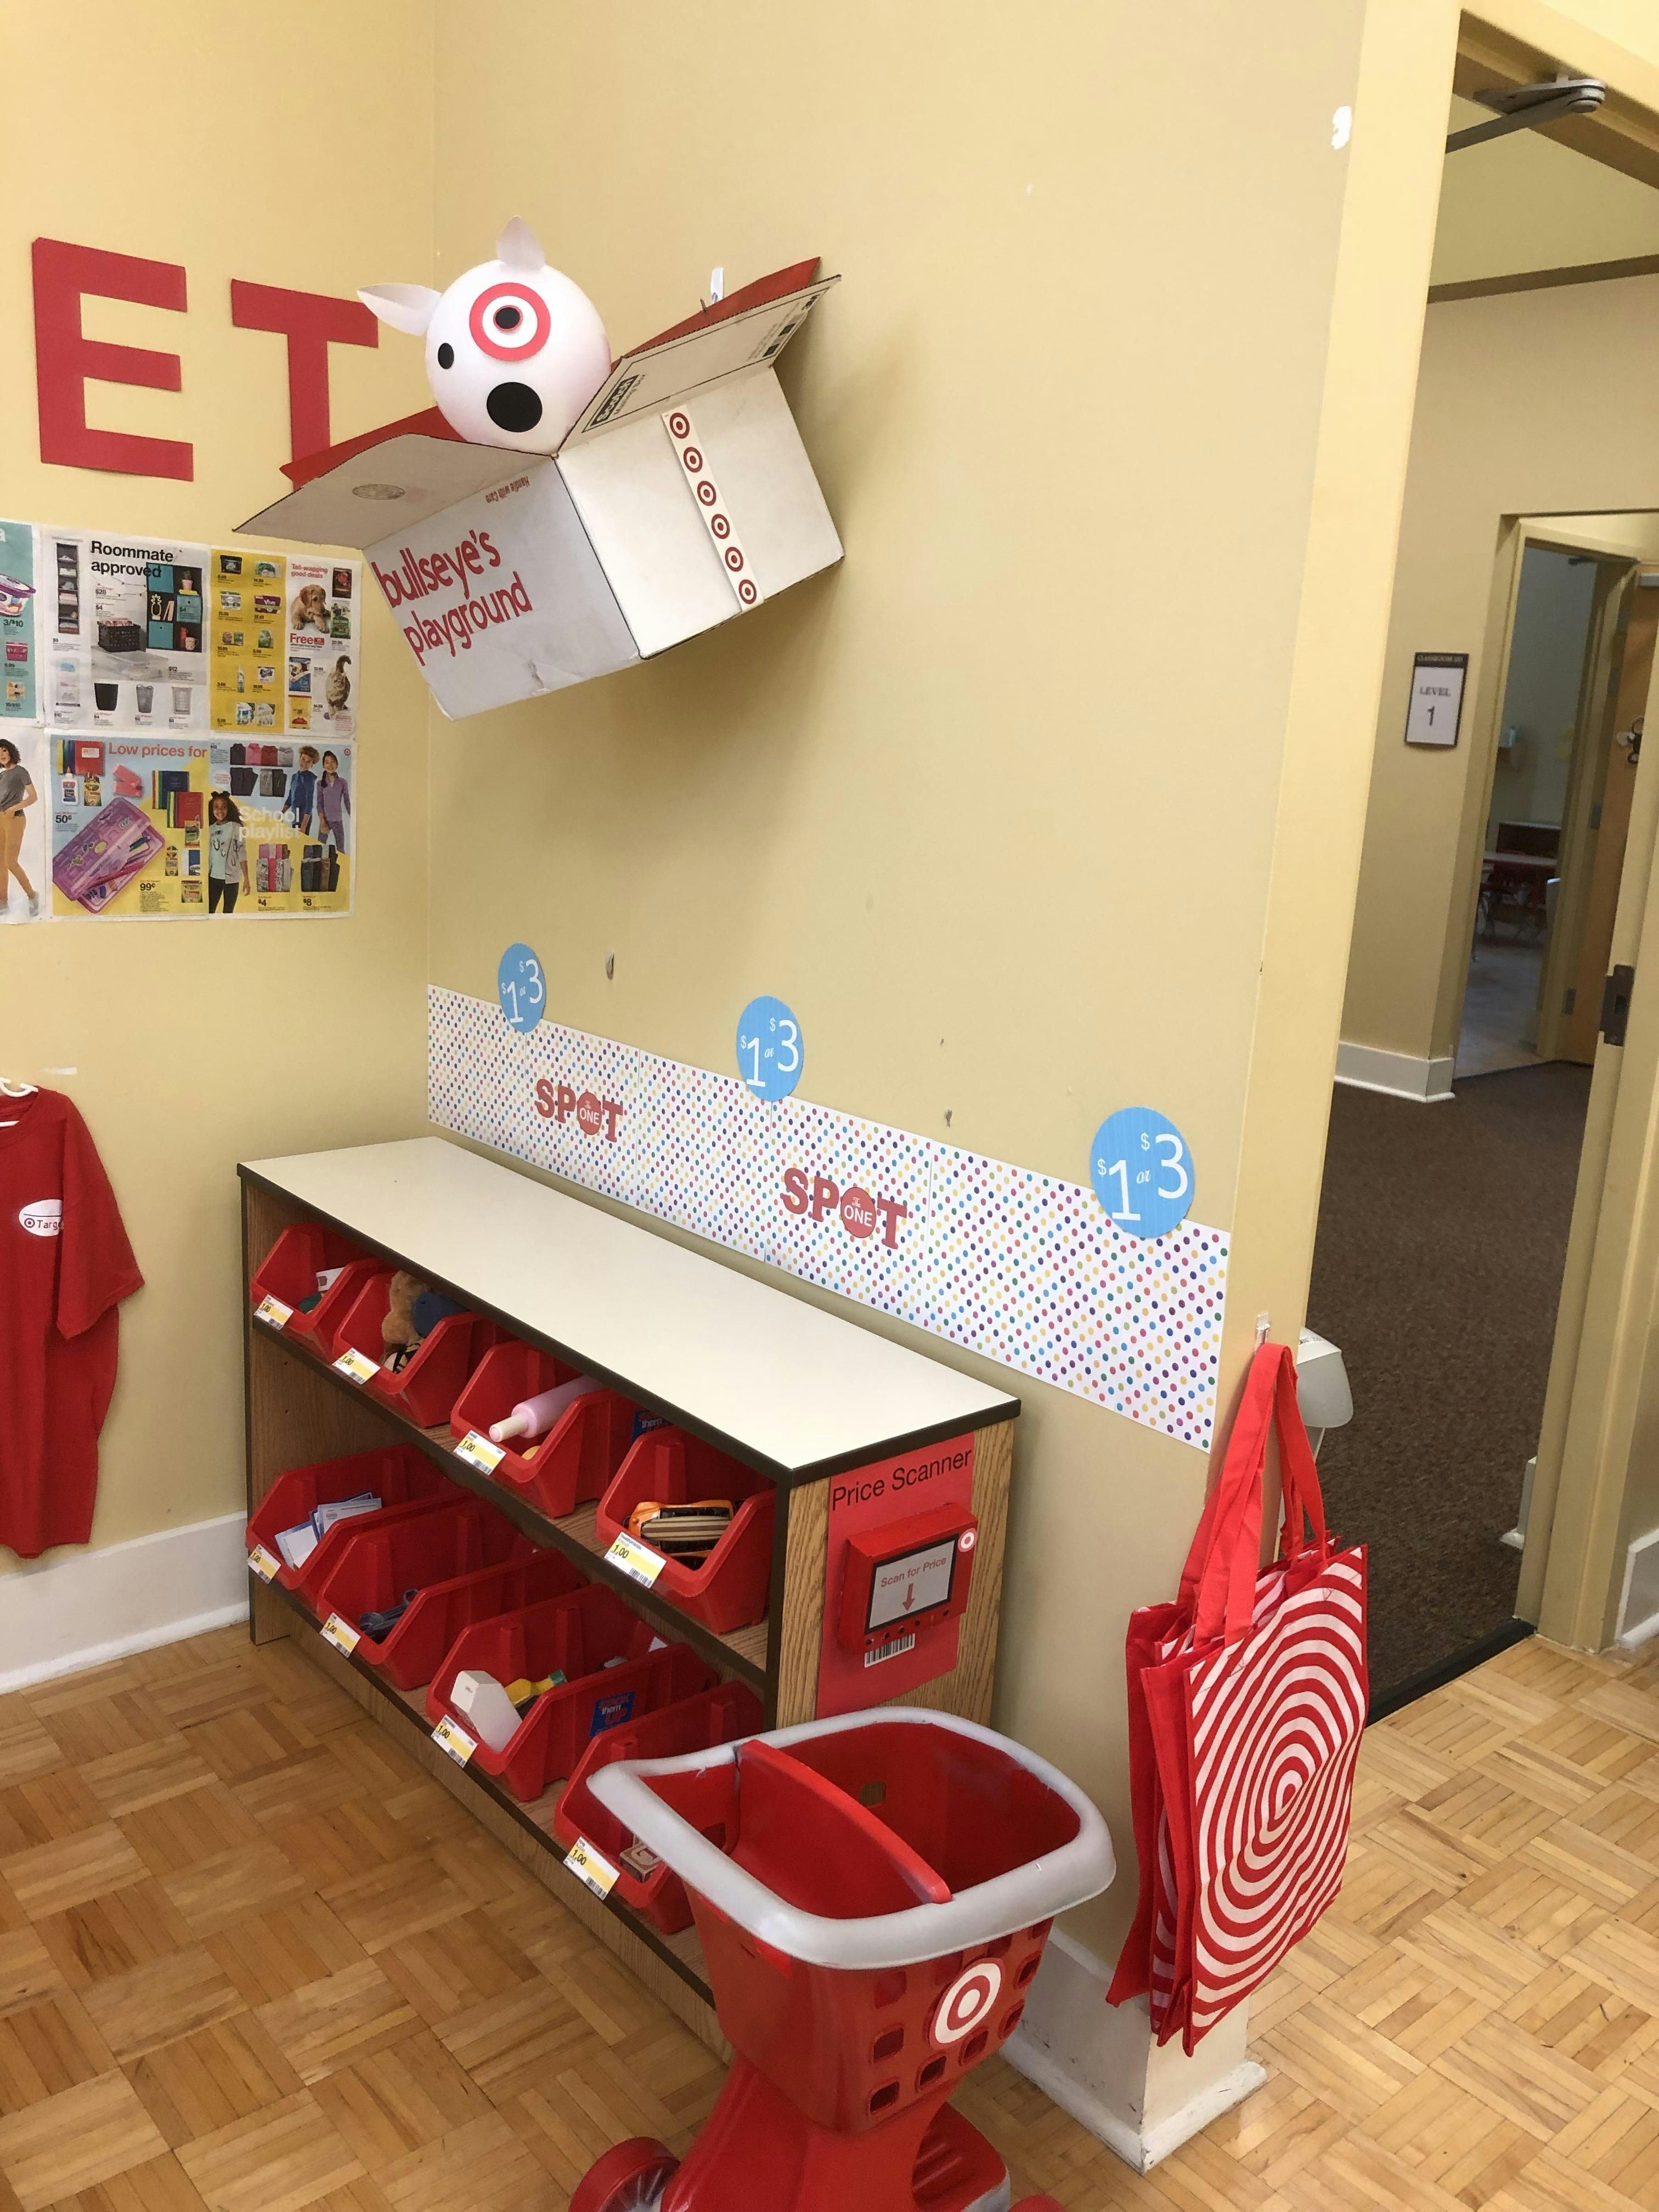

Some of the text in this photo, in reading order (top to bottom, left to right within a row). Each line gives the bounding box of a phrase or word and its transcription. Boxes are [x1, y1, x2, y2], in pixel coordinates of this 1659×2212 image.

[486, 476, 530, 503] Handle with Care
[91, 540, 173, 562] Roommate
[91, 561, 162, 578] approved
[292, 563, 328, 574] Tail-wagging
[371, 529, 501, 608] bullseye's
[403, 571, 533, 667] playground
[290, 633, 313, 644] Free
[1420, 686, 1451, 697] LEVEL
[1427, 706, 1435, 726] 1
[109, 742, 138, 754] Low
[142, 744, 185, 758] prices
[188, 746, 207, 758] for
[55, 815, 72, 823] 50¢
[239, 807, 300, 822] School
[239, 823, 301, 842] playlist
[140, 883, 156, 891] 99¢
[501, 980, 524, 1023] $1
[519, 958, 543, 1003] $3
[741, 1035, 766, 1087] $1
[769, 1017, 799, 1072] $3
[580, 1107, 600, 1125] ONE
[1097, 1158, 1142, 1221] $1
[1139, 1132, 1189, 1200] $3
[844, 1204, 873, 1227] ONE
[461, 1440, 476, 1452] 1.00
[832, 1449, 972, 1511] Price Scanner
[612, 1543, 629, 1560] 1.00
[881, 1556, 947, 1588] Scan for Price
[438, 1724, 450, 1740] 1.00
[572, 1849, 588, 1866] 1.00
